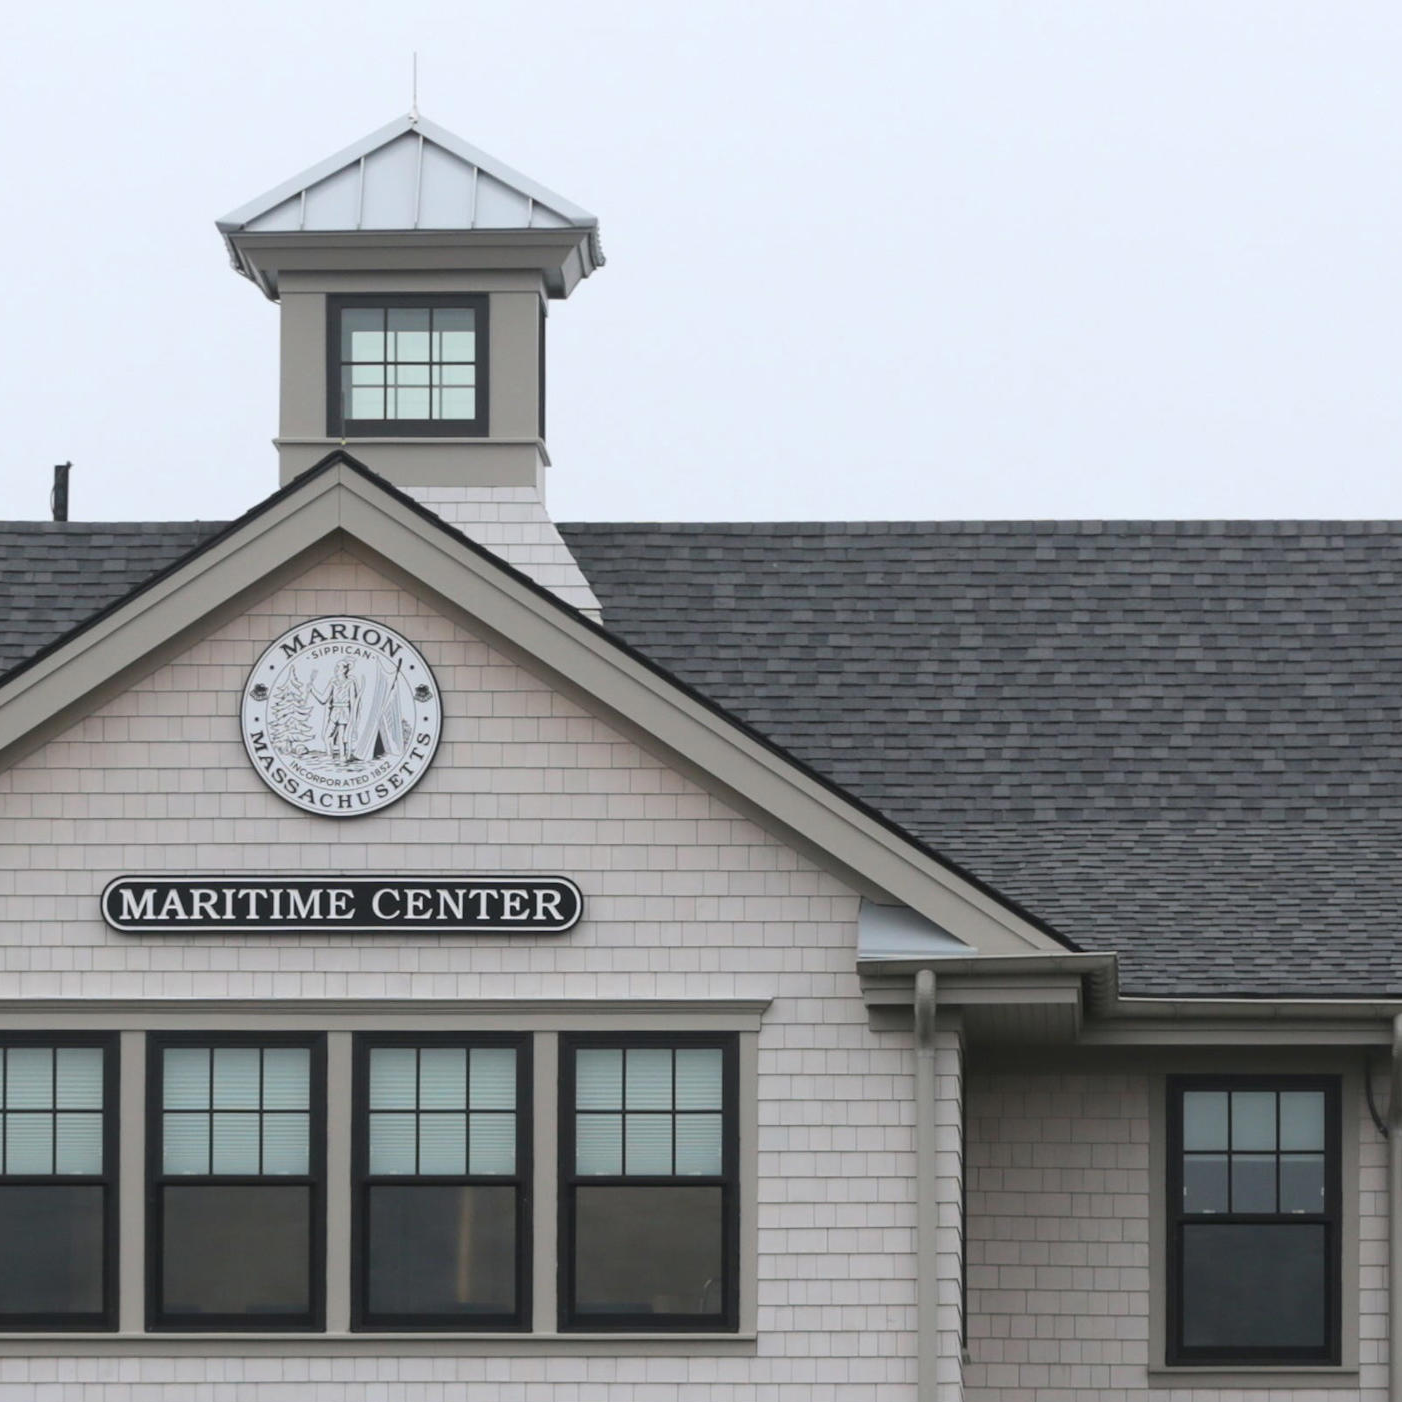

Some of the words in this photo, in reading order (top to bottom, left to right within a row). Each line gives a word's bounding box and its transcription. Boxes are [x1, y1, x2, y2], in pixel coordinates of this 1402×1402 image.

[279, 623, 402, 660] MARION
[311, 645, 372, 660] SIPPICAN
[250, 730, 432, 809] MASSACHUSETTS
[289, 760, 370, 787] INCORPORATED
[370, 760, 392, 779] 1852
[118, 888, 356, 920] MARITIME
[371, 888, 564, 920] CENTER
